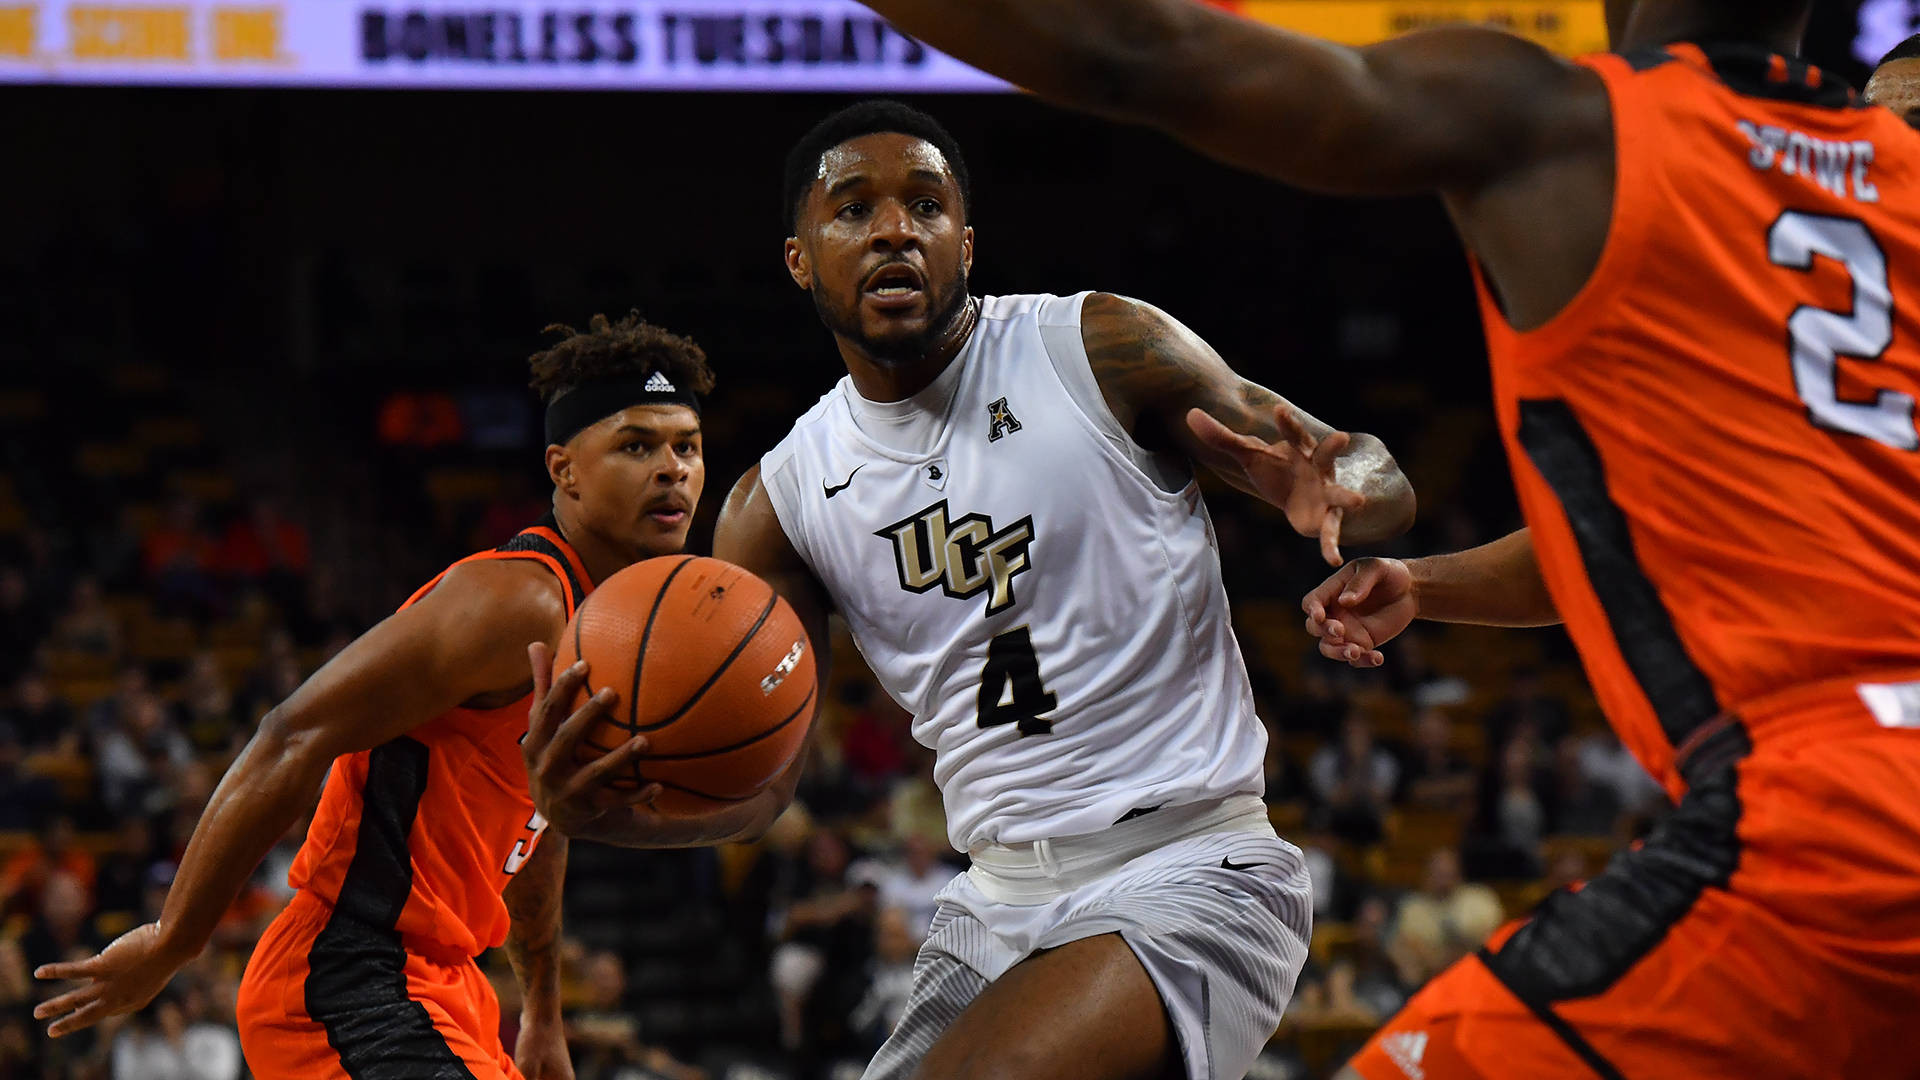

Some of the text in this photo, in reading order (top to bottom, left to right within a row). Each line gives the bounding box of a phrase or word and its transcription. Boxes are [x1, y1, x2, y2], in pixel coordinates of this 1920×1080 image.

[361, 11, 926, 64] BONELESS TUESDAYS
[1767, 208, 1919, 450] 2
[644, 383, 676, 393] adidas
[873, 498, 1035, 618] UCF
[976, 623, 1057, 736] 4
